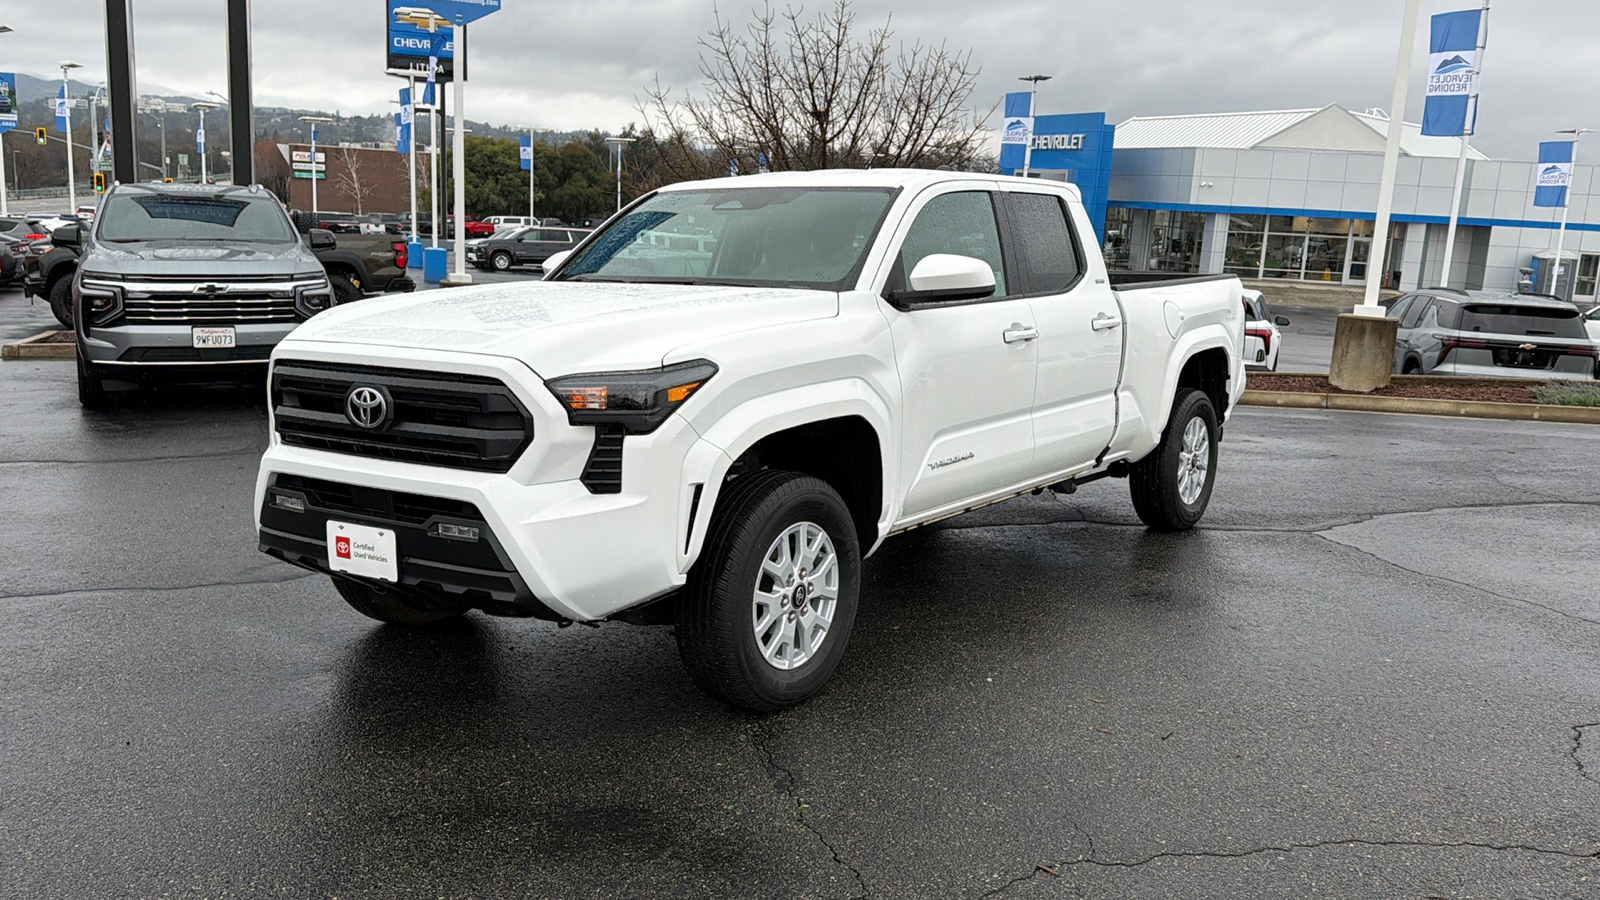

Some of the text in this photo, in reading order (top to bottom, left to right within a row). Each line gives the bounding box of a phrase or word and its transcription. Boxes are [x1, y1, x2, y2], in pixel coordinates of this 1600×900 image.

[1031, 133, 1086, 151] CHEVROLET
[196, 335, 233, 345] 9WFU073
[928, 452, 975, 470] TACOMA
[353, 542, 374, 552] Certified
[354, 551, 388, 563] Used Vehicles
